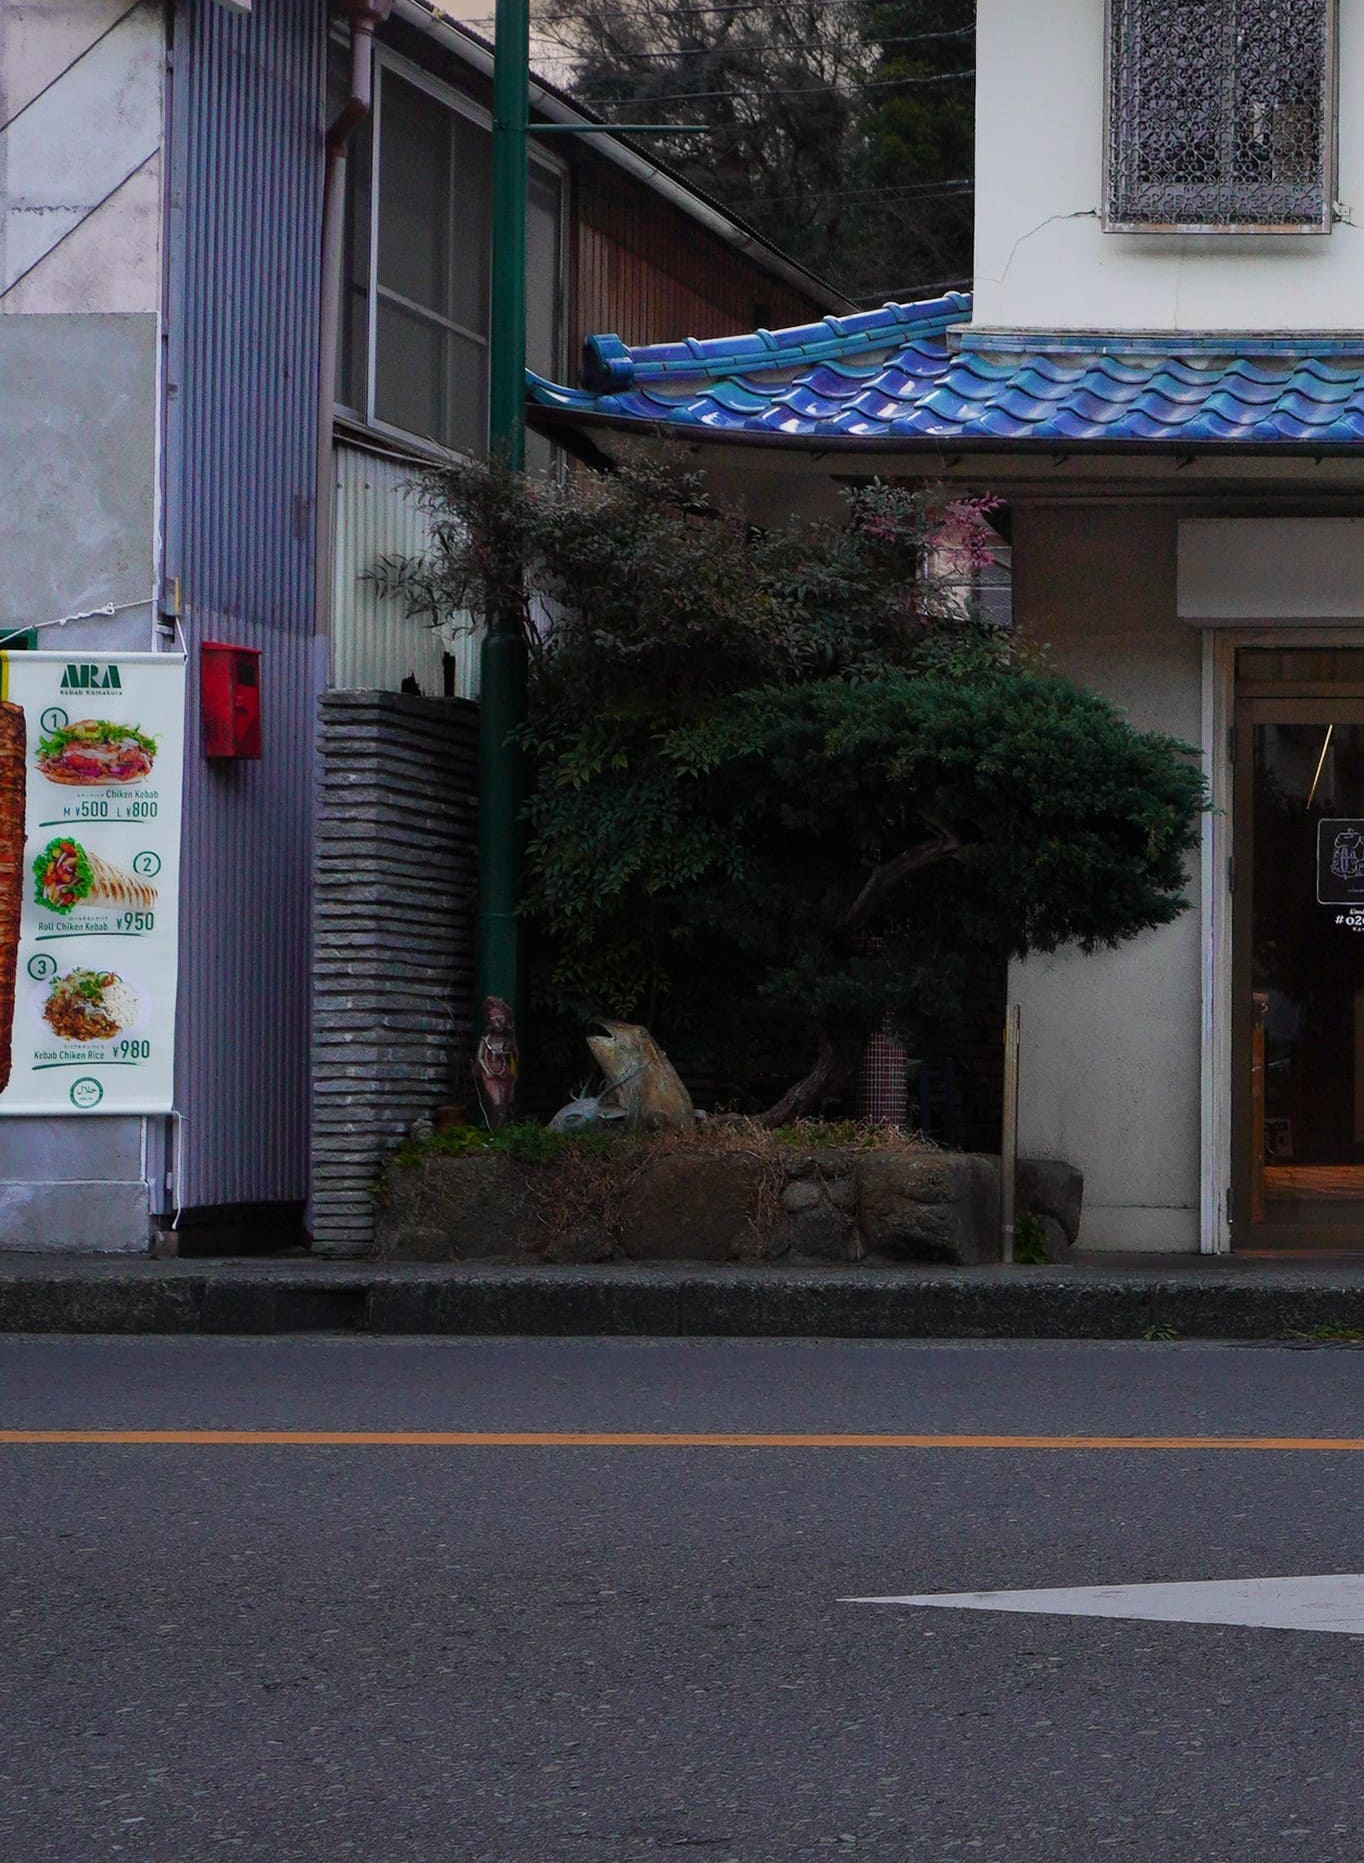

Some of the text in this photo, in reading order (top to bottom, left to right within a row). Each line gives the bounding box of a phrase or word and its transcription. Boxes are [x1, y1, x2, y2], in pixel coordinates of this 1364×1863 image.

[60, 664, 122, 689] ARA
[106, 789, 133, 799] Chiken
[135, 789, 159, 799] Kebab
[63, 807, 71, 817] M
[75, 800, 108, 817] ¥500
[126, 801, 158, 817] ¥800
[38, 921, 108, 931] Roll Chiken Kebab
[116, 911, 154, 931] ¥950
[34, 1050, 57, 1060] Kebab
[59, 1050, 86, 1059] Chiken
[88, 1050, 104, 1059] Rice
[112, 1040, 150, 1058] ¥980
